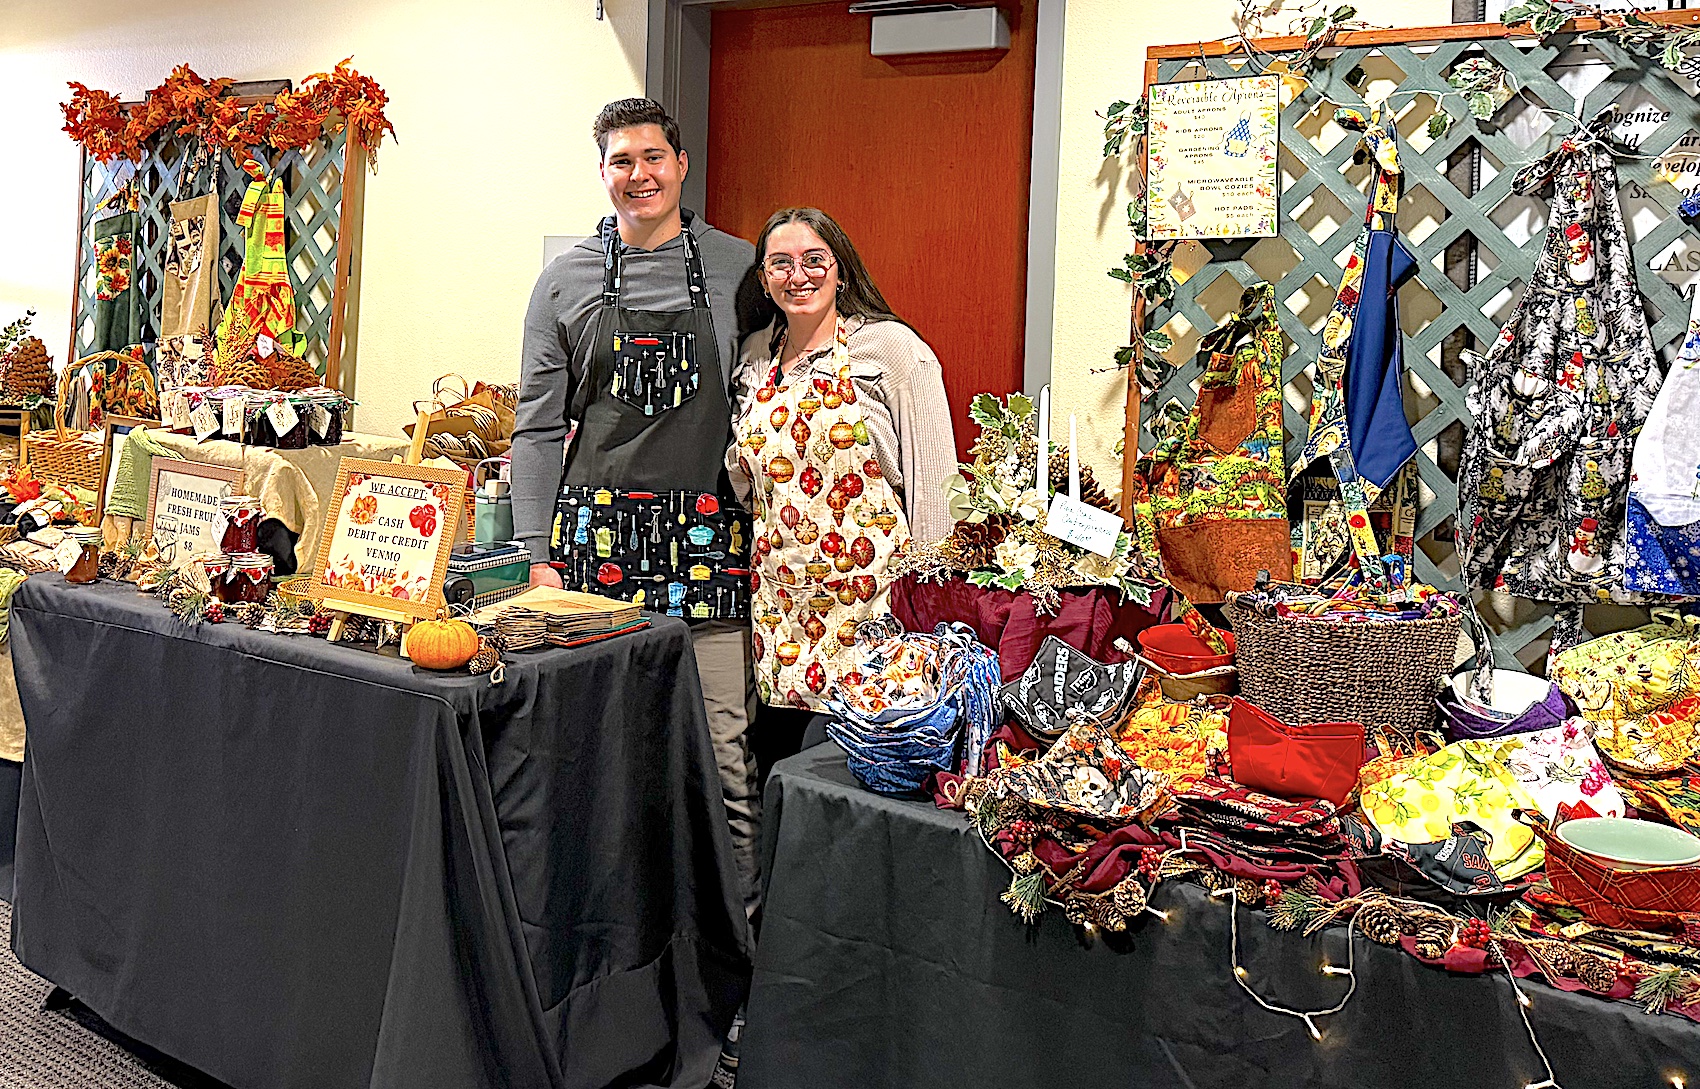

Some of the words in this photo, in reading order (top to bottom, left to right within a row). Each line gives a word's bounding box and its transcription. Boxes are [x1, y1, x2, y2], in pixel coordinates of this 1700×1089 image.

[1221, 88, 1264, 104] Aprons
[1613, 107, 1671, 127] ognize
[1187, 176, 1254, 184] MICROWAVEABLE
[171, 487, 219, 507] HOMEMADE
[370, 482, 386, 493] WE
[387, 484, 428, 500] ACCEPT:
[167, 503, 193, 518] FRESH
[179, 522, 201, 536] JAMS
[378, 516, 405, 529] CASH
[183, 540, 193, 552] $8
[347, 528, 377, 541] DEBIT
[378, 534, 390, 543] or
[391, 535, 430, 550] CREDIT
[366, 547, 401, 562] VENMO
[364, 564, 395, 579] ZELLE
[1053, 647, 1070, 704] RAIDERS
